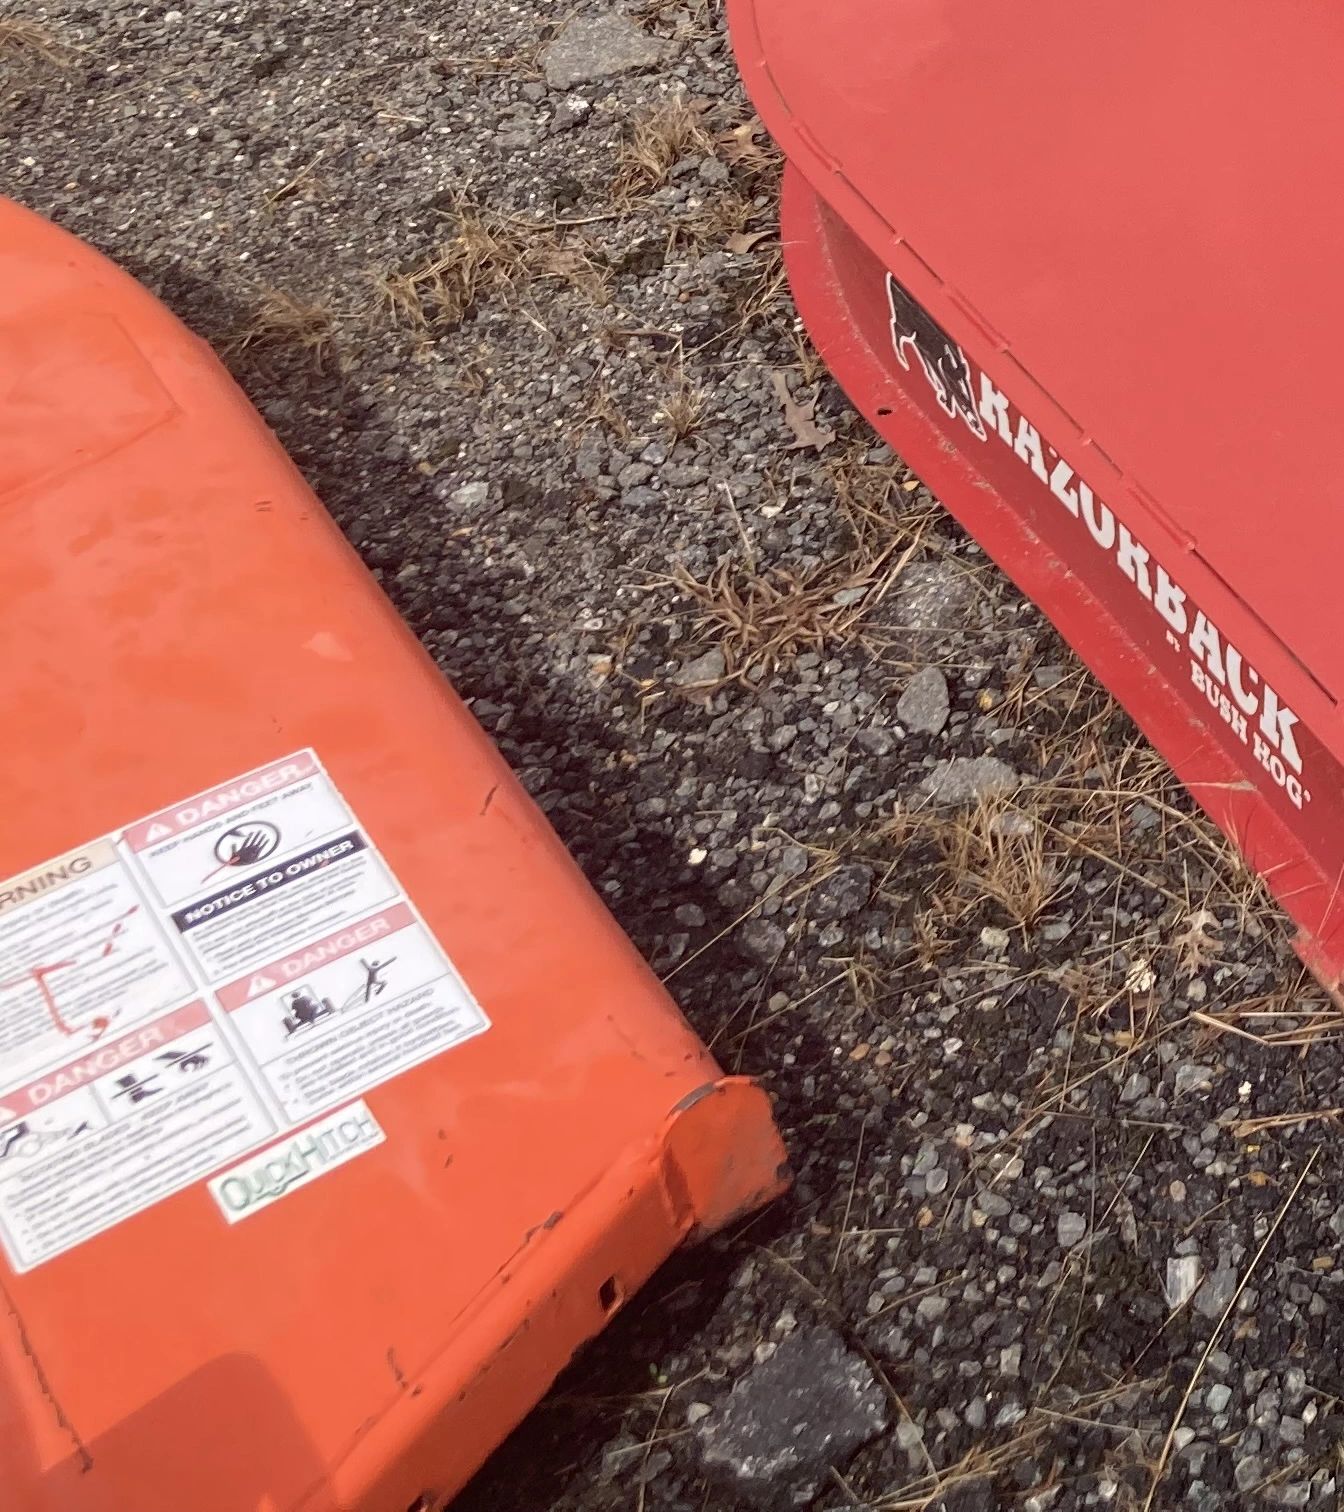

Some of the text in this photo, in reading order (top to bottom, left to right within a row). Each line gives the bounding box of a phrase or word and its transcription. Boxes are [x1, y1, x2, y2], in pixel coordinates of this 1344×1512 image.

[1190, 658, 1249, 746] BUSH
[173, 762, 304, 827] DANGER
[180, 820, 223, 843] HANDS
[182, 838, 355, 923] NOTICE TO OWNER
[278, 916, 392, 977] DANGER
[337, 1011, 385, 1038] OBJECT
[384, 986, 436, 1015] HAZARD
[27, 1024, 165, 1108] DANGER
